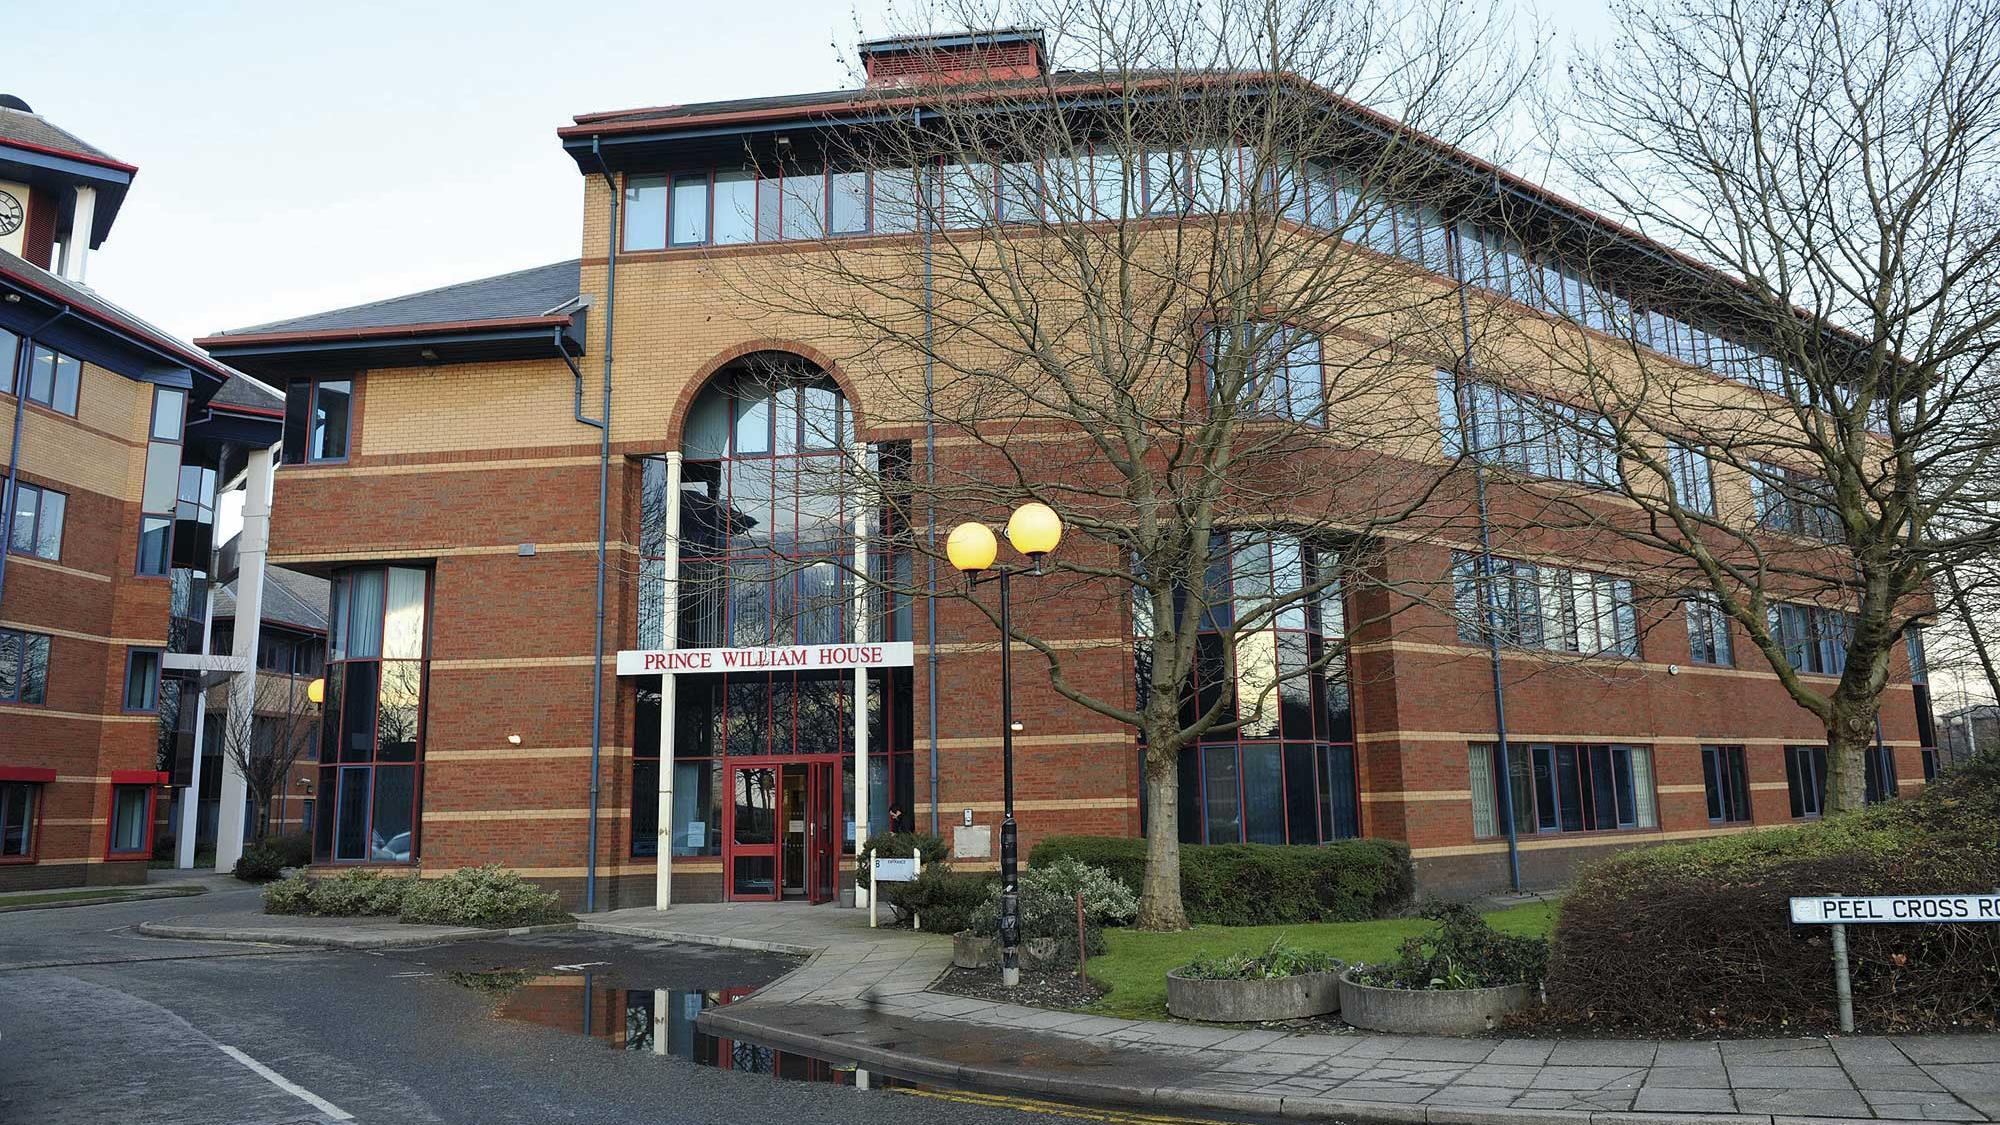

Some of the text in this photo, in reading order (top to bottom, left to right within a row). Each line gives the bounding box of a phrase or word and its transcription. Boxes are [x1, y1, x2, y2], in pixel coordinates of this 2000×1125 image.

[645, 647, 883, 670] PRINCE WILLIAM HOUSE
[1823, 900, 1883, 919] PEEL
[1892, 899, 1969, 918] CROSS
